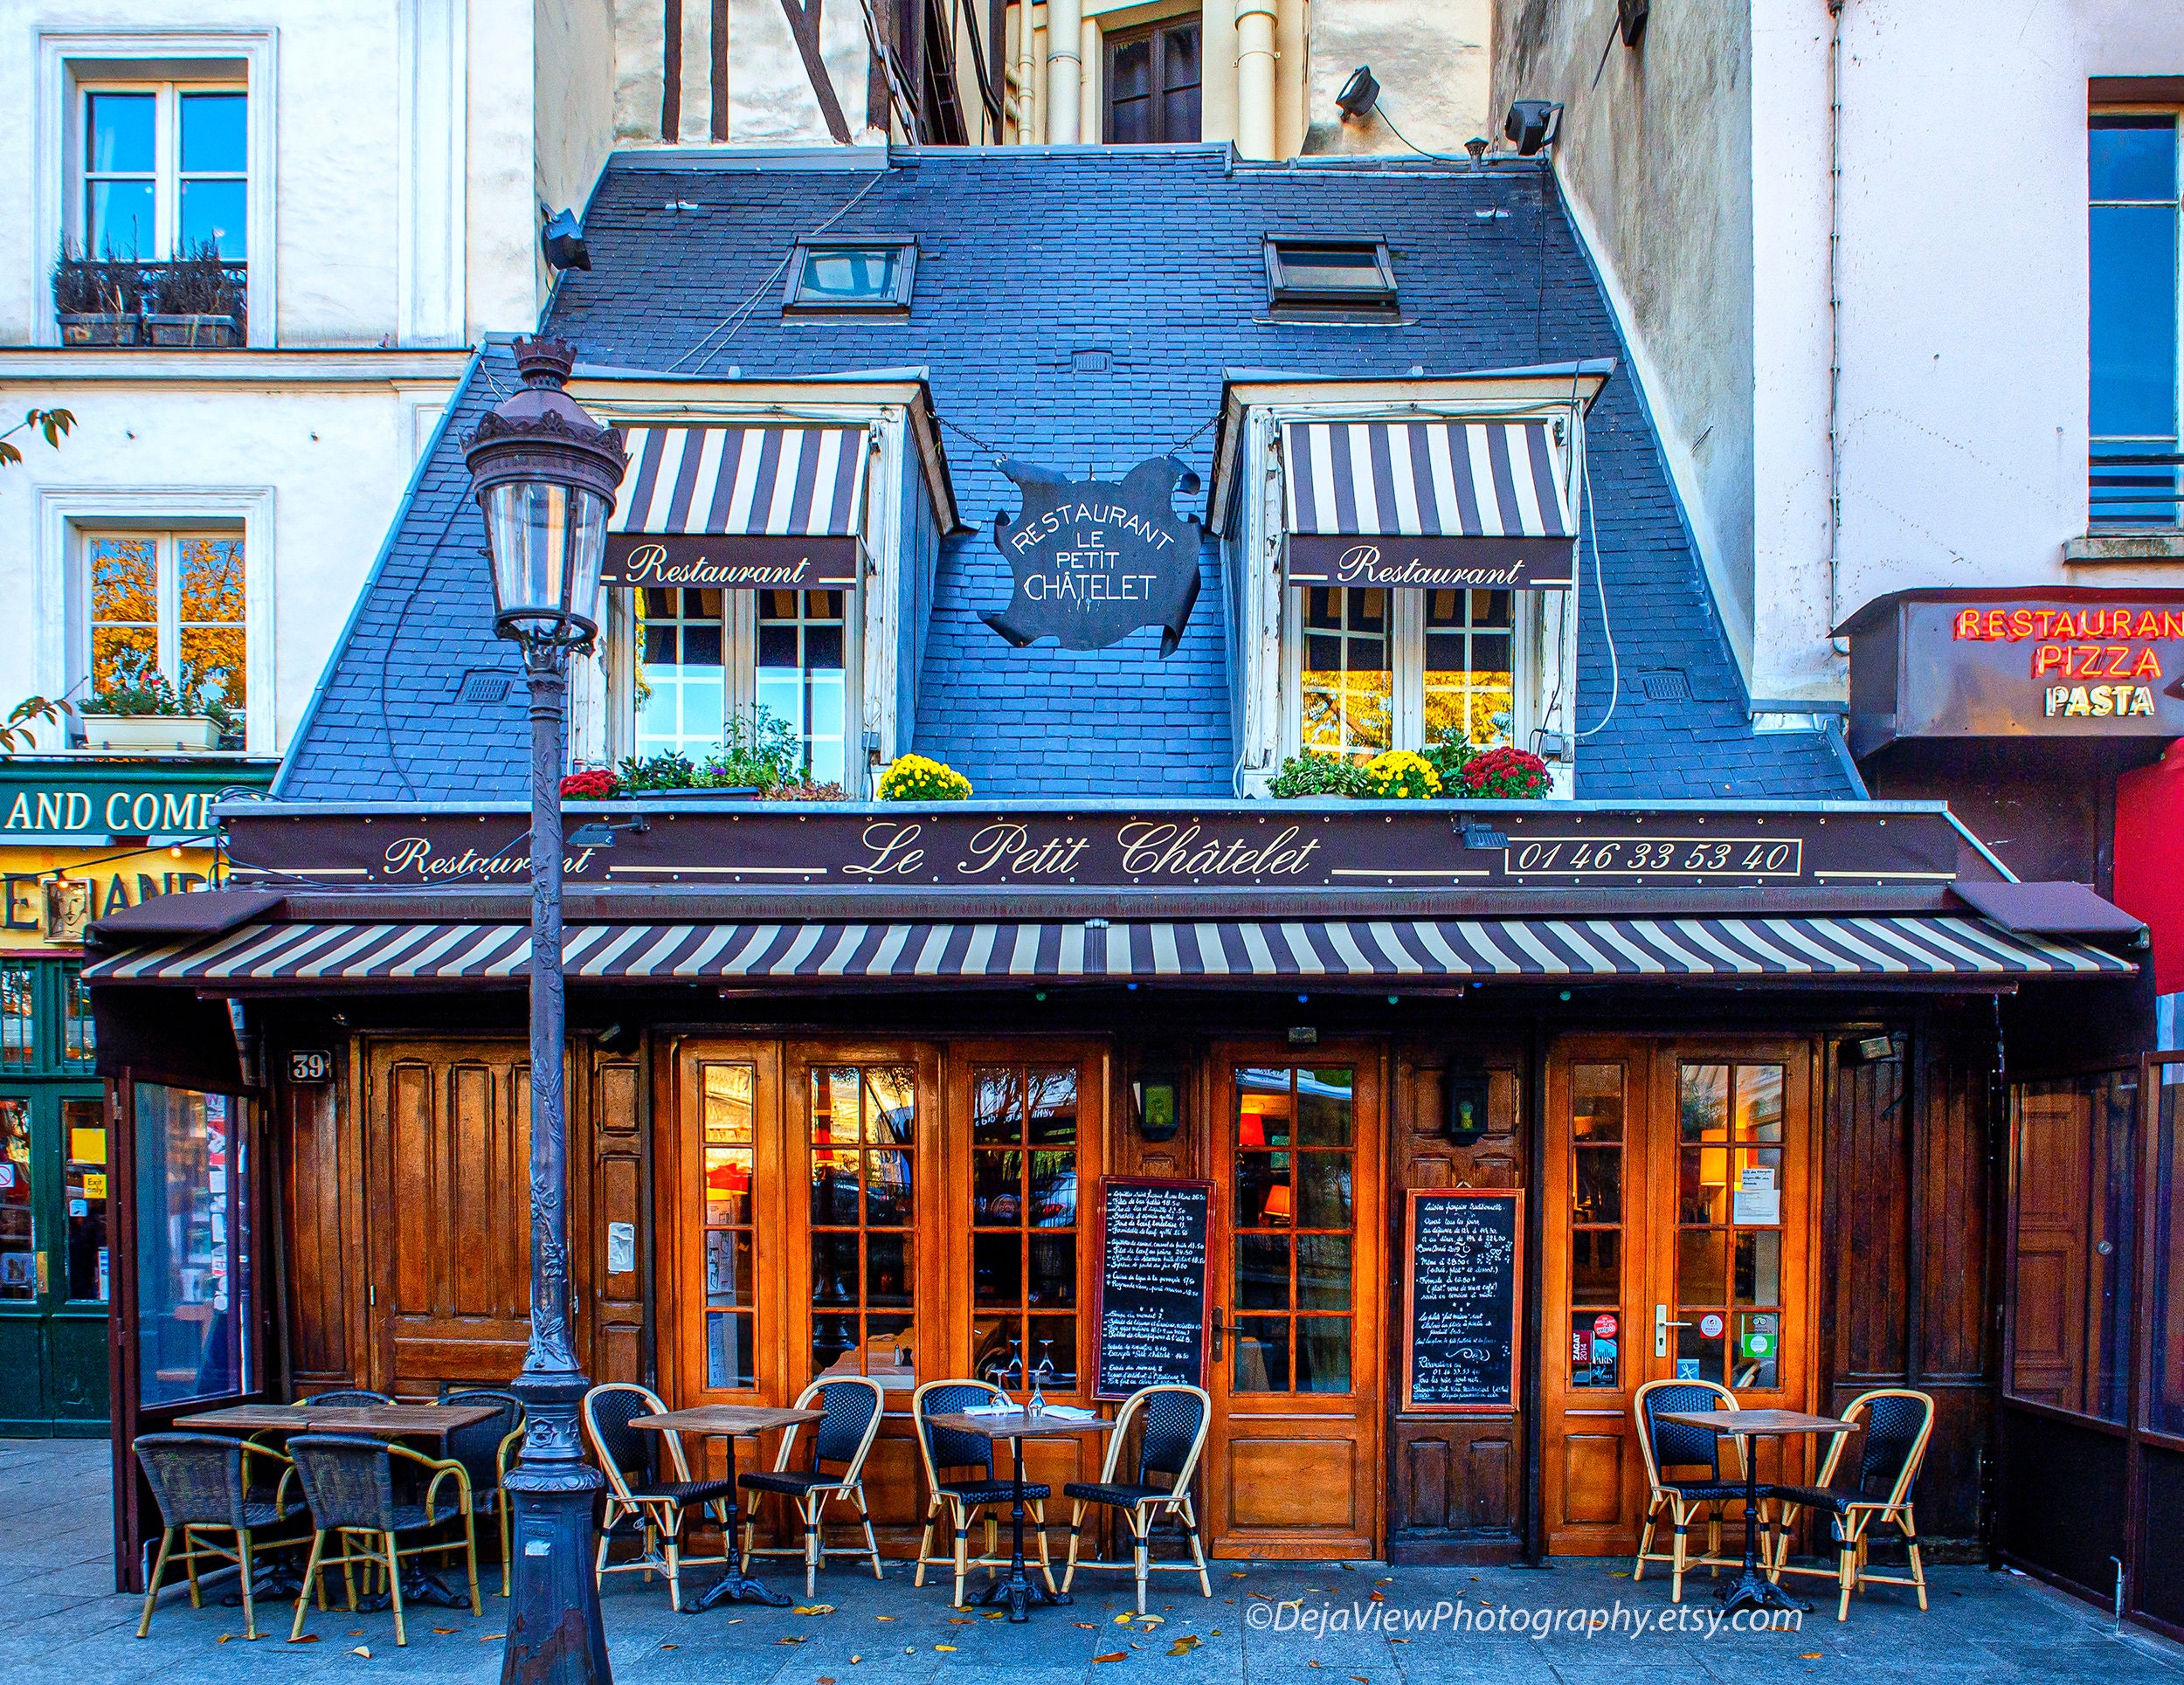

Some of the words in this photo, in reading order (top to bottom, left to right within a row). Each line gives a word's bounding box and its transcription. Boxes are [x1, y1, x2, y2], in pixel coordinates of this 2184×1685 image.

[1011, 502, 1175, 555] RESTAURANT
[1076, 530, 1105, 549] LE
[625, 543, 811, 584] Restaurant
[1056, 550, 1120, 570] PETIT
[1337, 545, 1525, 585] Restaurant
[1023, 570, 1158, 601] CHÂTELET
[2032, 645, 2162, 679] PIZZA
[2044, 685, 2155, 717] PASTA
[3, 791, 93, 831] AND
[383, 837, 596, 875] Restaurnt
[842, 822, 925, 875] Le
[957, 823, 1090, 875] Petit
[1116, 821, 1322, 875] Châtelet
[1518, 842, 1565, 870] 01
[1570, 842, 1622, 870] 46
[1628, 843, 1671, 870] 33
[1684, 843, 1730, 870] 53
[1742, 844, 1791, 871] 40
[293, 1054, 324, 1079] 39
[87, 1177, 102, 1186] Exit
[1594, 1356, 1613, 1364] PARIS
